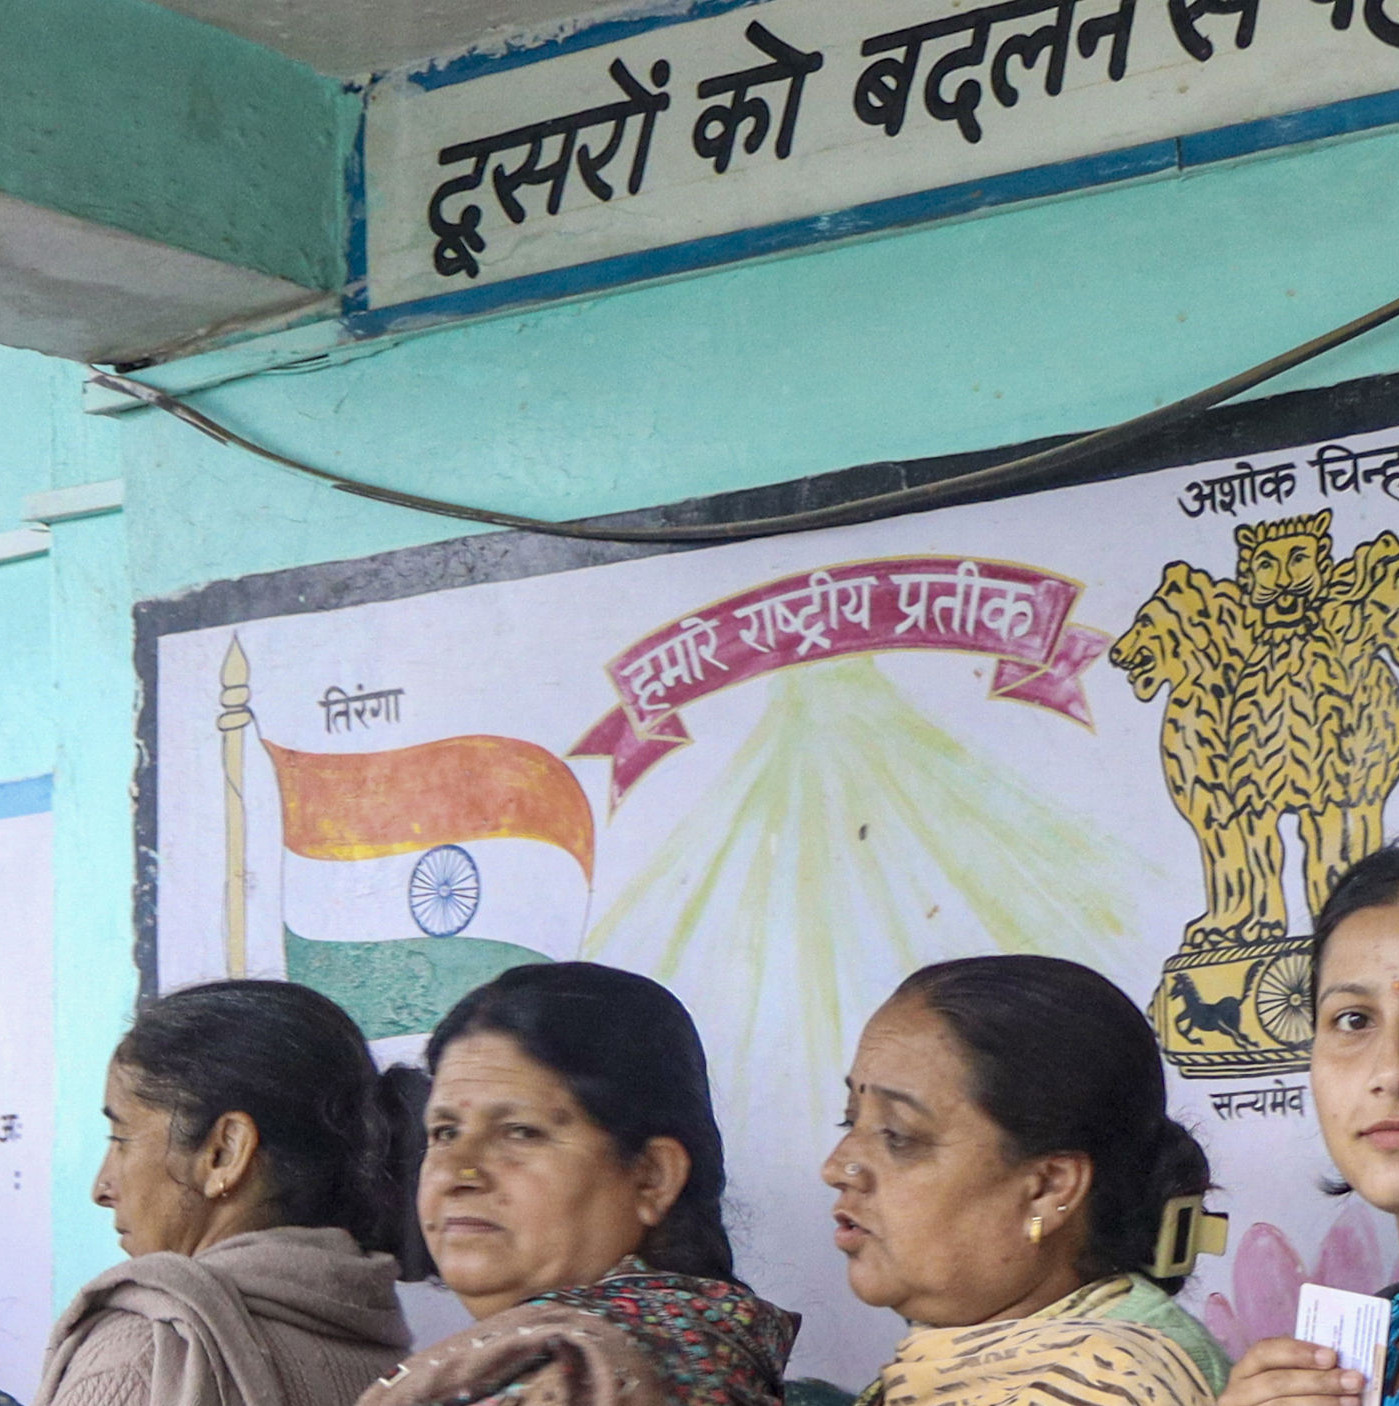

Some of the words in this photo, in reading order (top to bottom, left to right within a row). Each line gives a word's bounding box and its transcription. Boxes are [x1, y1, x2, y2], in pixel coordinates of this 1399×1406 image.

[427, 58, 672, 278] दूसरों
[692, 20, 823, 174] को
[1178, 461, 1296, 517] अशोक
[620, 617, 729, 712] हमारे
[734, 571, 879, 654] राष्ट्रीय
[889, 560, 1036, 638] प्रतीक
[317, 683, 405, 735] तिरंगा
[1209, 1079, 1308, 1120] सत्यमेव
